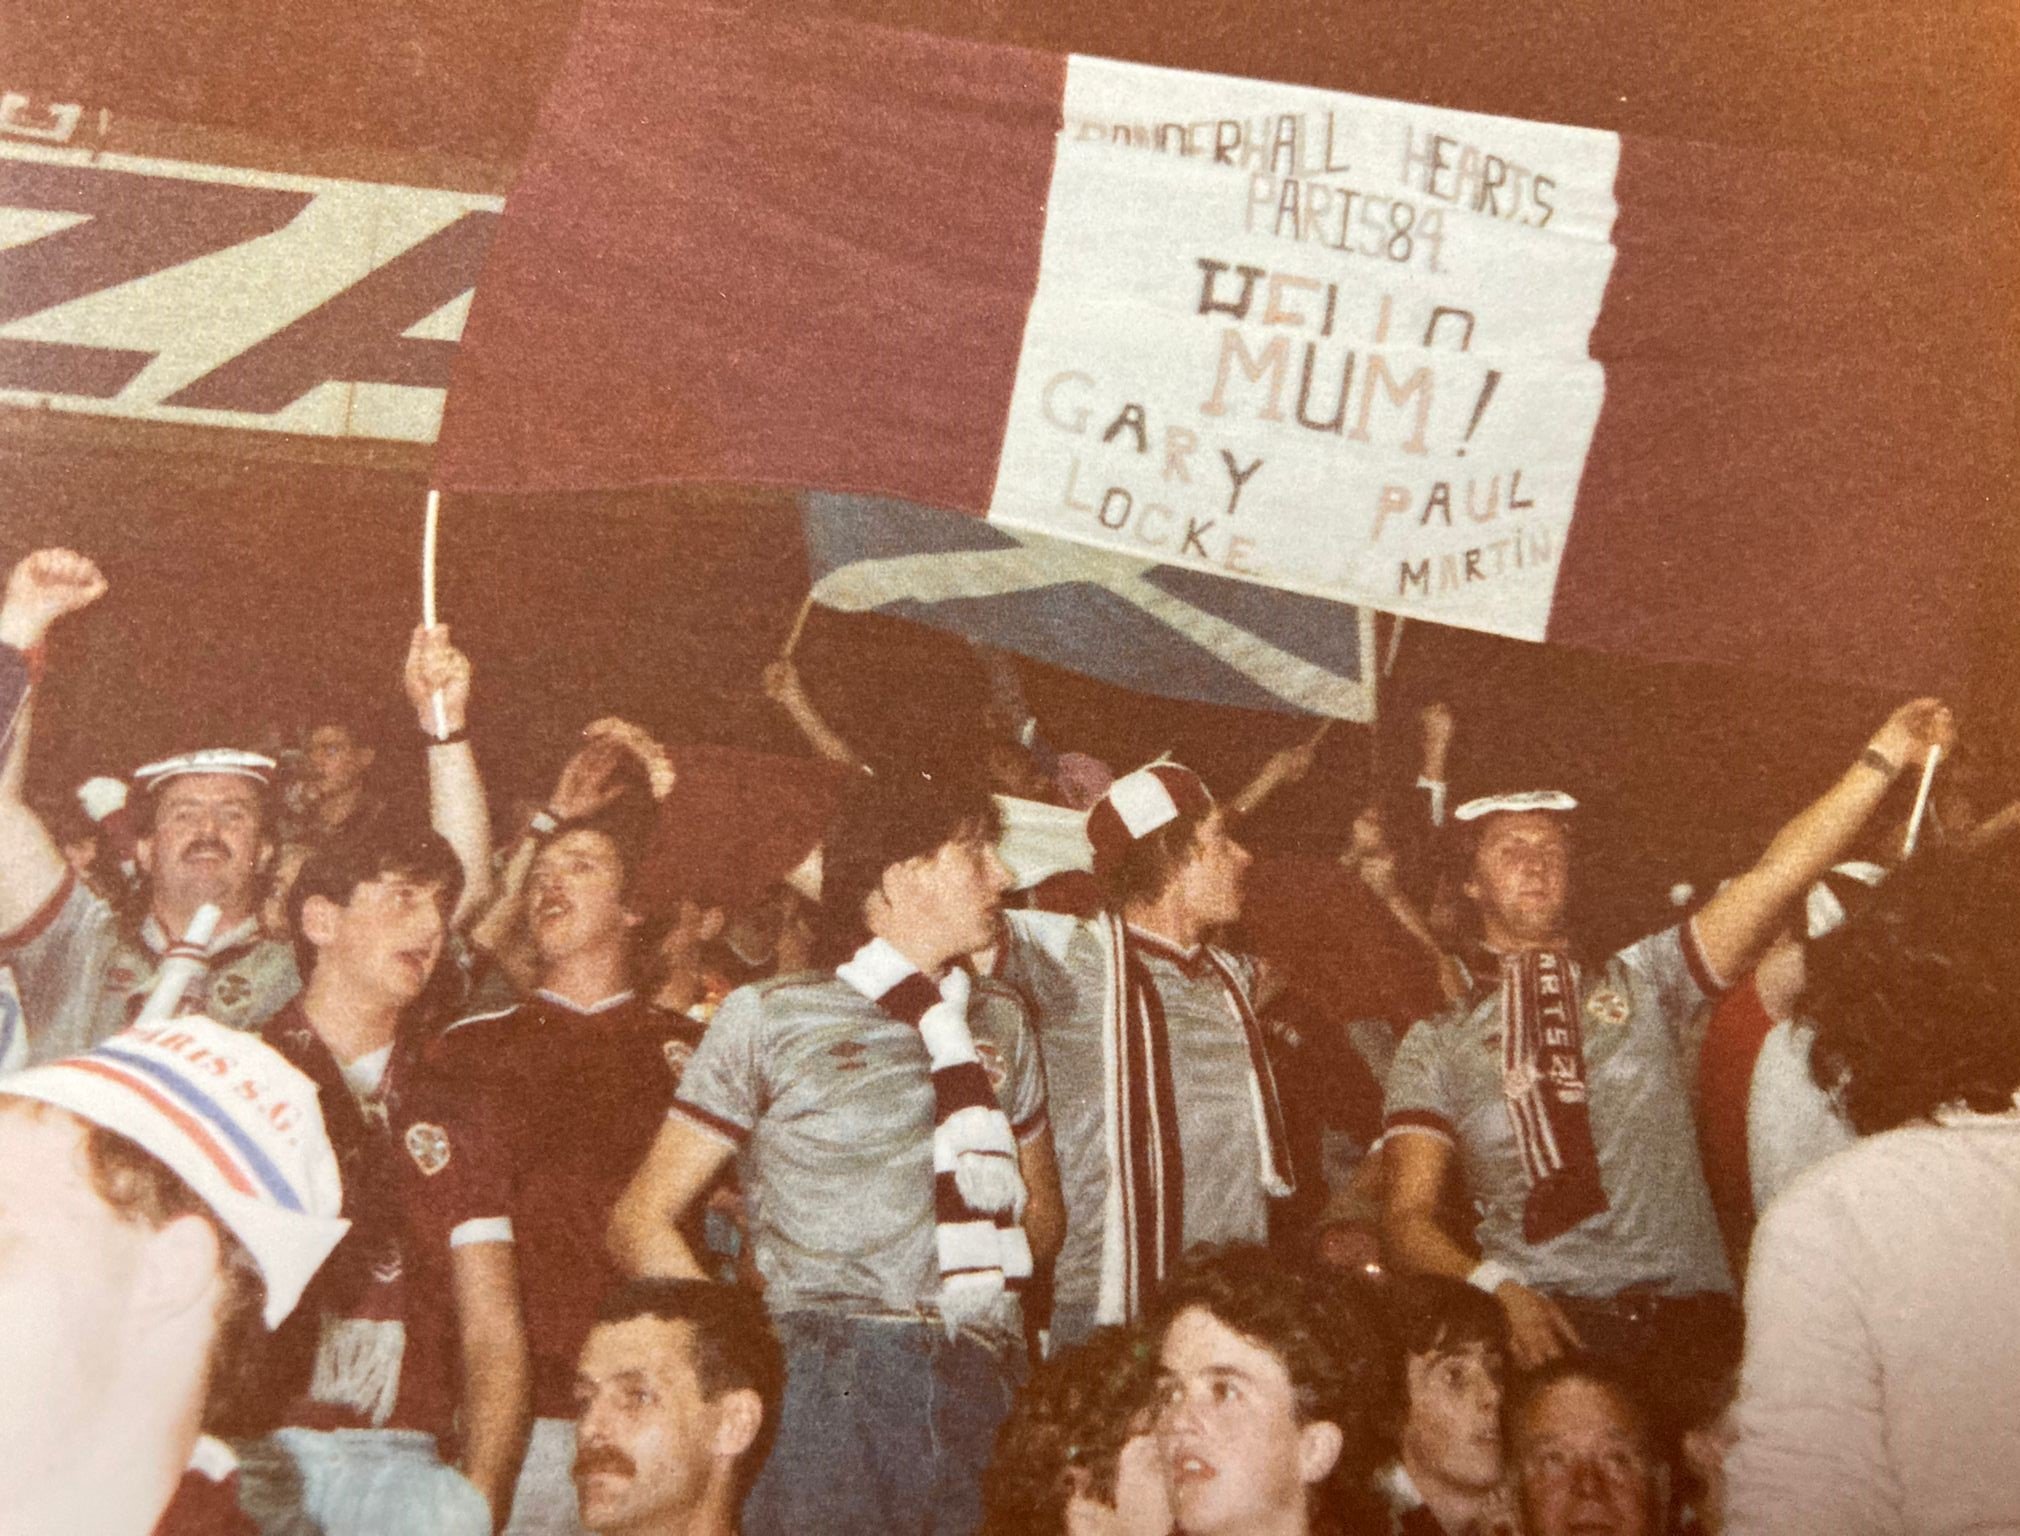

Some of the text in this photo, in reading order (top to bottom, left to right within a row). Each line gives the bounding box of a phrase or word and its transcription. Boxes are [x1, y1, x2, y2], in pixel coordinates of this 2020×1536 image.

[1404, 125, 1556, 229] HEARTS
[1040, 369, 1264, 515] GARY
[1200, 327, 1502, 459] MUM!
[1062, 457, 1258, 574] LOCKE
[1371, 468, 1535, 542] PAUL
[1398, 522, 1553, 597] MARTIN
